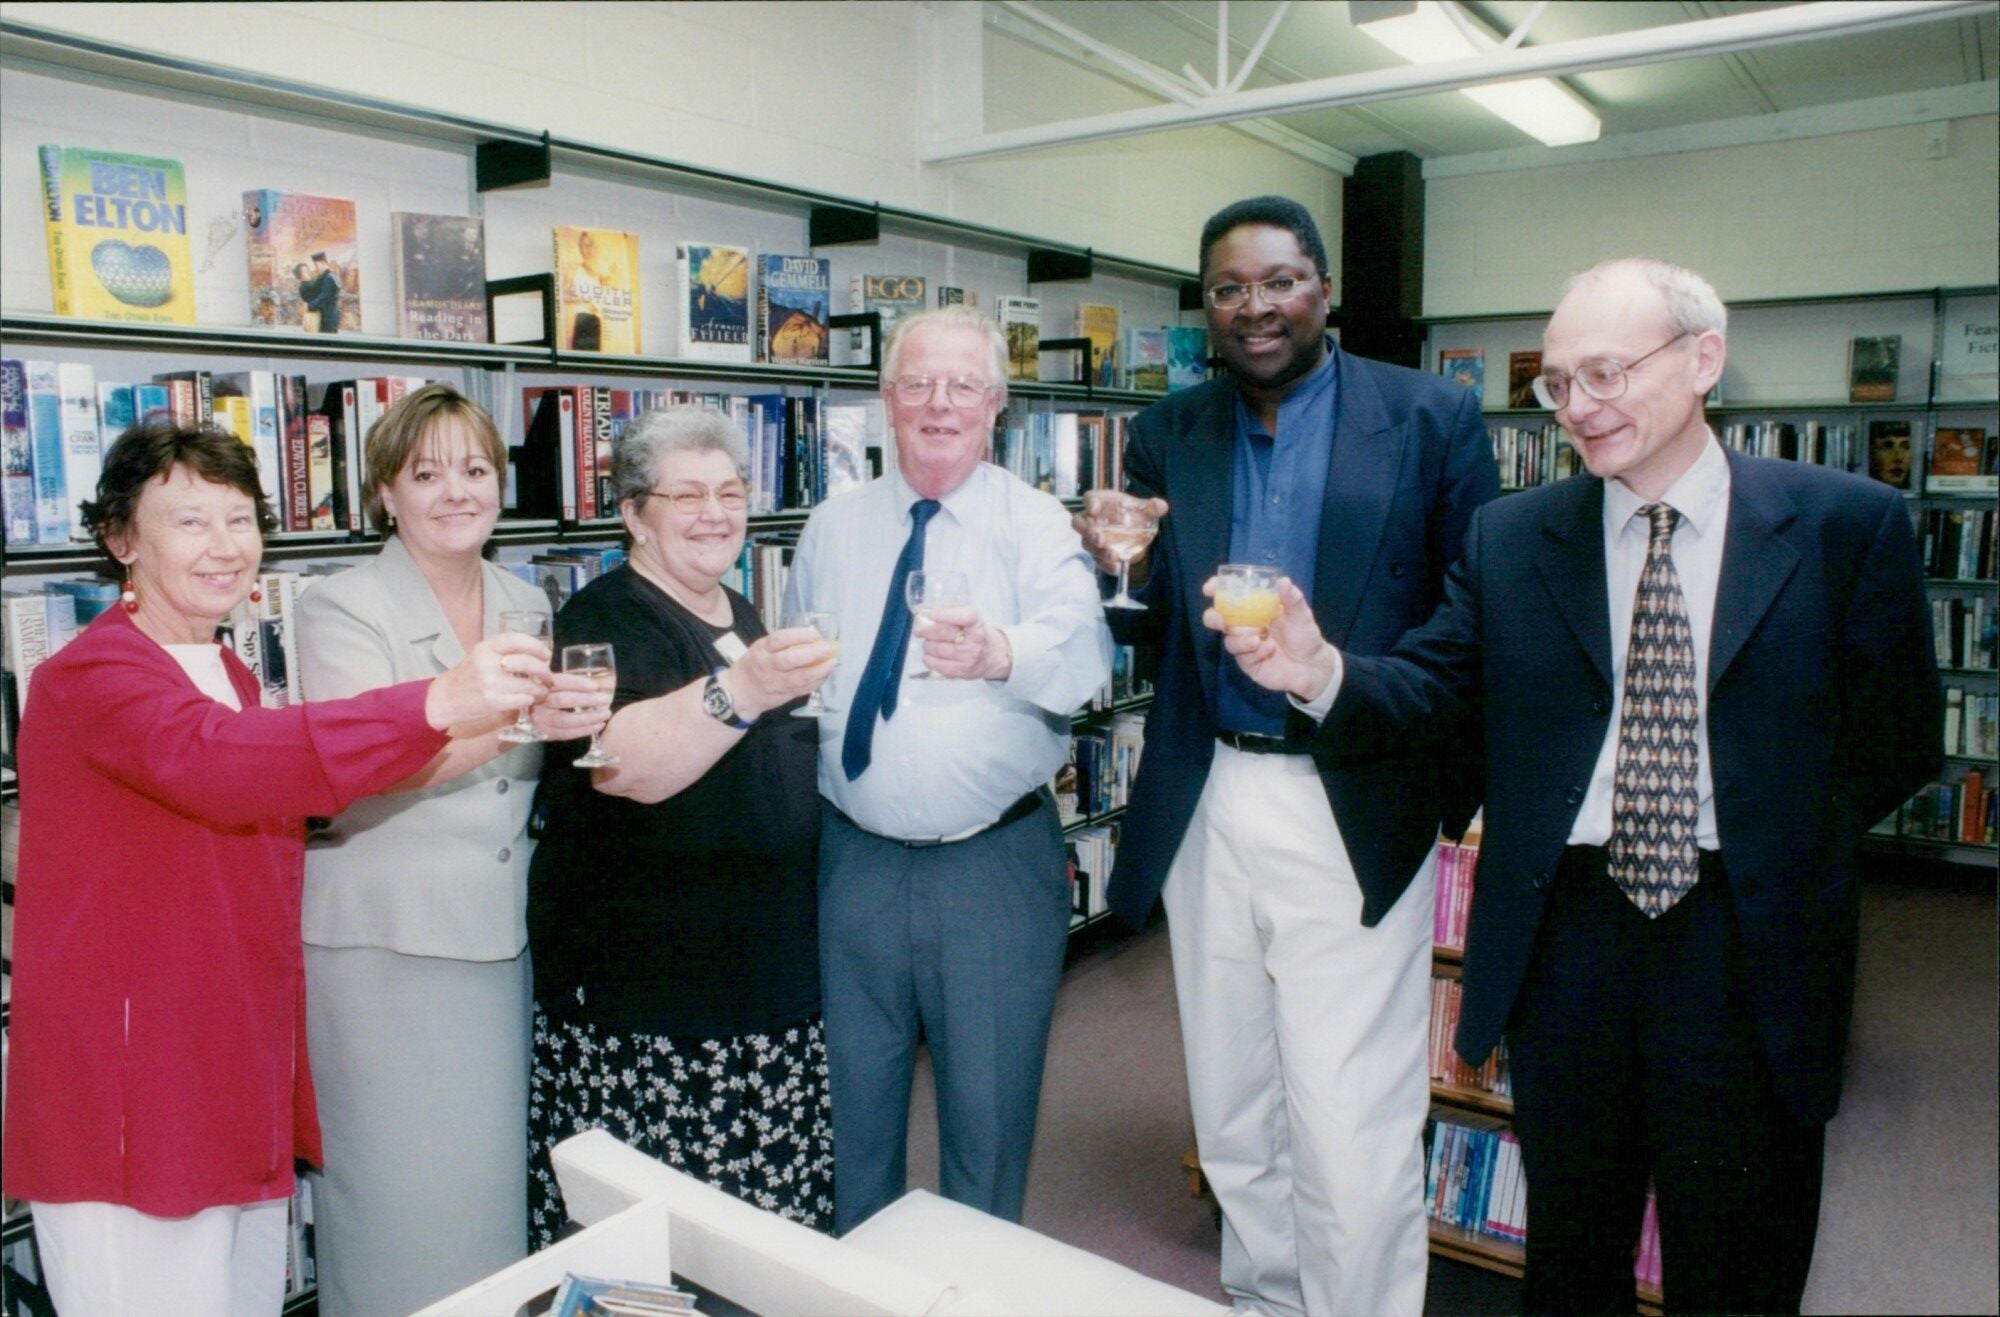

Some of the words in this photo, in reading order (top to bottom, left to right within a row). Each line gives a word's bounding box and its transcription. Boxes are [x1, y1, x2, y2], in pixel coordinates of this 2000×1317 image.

[90, 161, 167, 201] BEN
[73, 193, 187, 236] ELTON
[770, 272, 828, 291] GEMMELL
[782, 257, 819, 276] DAVID
[409, 310, 464, 329] Reading
[470, 313, 482, 325] in
[417, 327, 440, 340] the
[445, 328, 474, 341] Dark
[1964, 323, 1998, 336] Feas
[1968, 341, 1998, 354] Fict
[581, 388, 592, 417] COLIN
[597, 389, 611, 441] TRIAD
[583, 417, 594, 467] FALCONER
[291, 438, 304, 480] EDWINA
[294, 481, 307, 517] CURRIE
[585, 470, 595, 503] HAREM
[267, 578, 282, 616] DEIGHTON
[20, 618, 35, 661] SAMUEL
[243, 631, 257, 658] Spy
